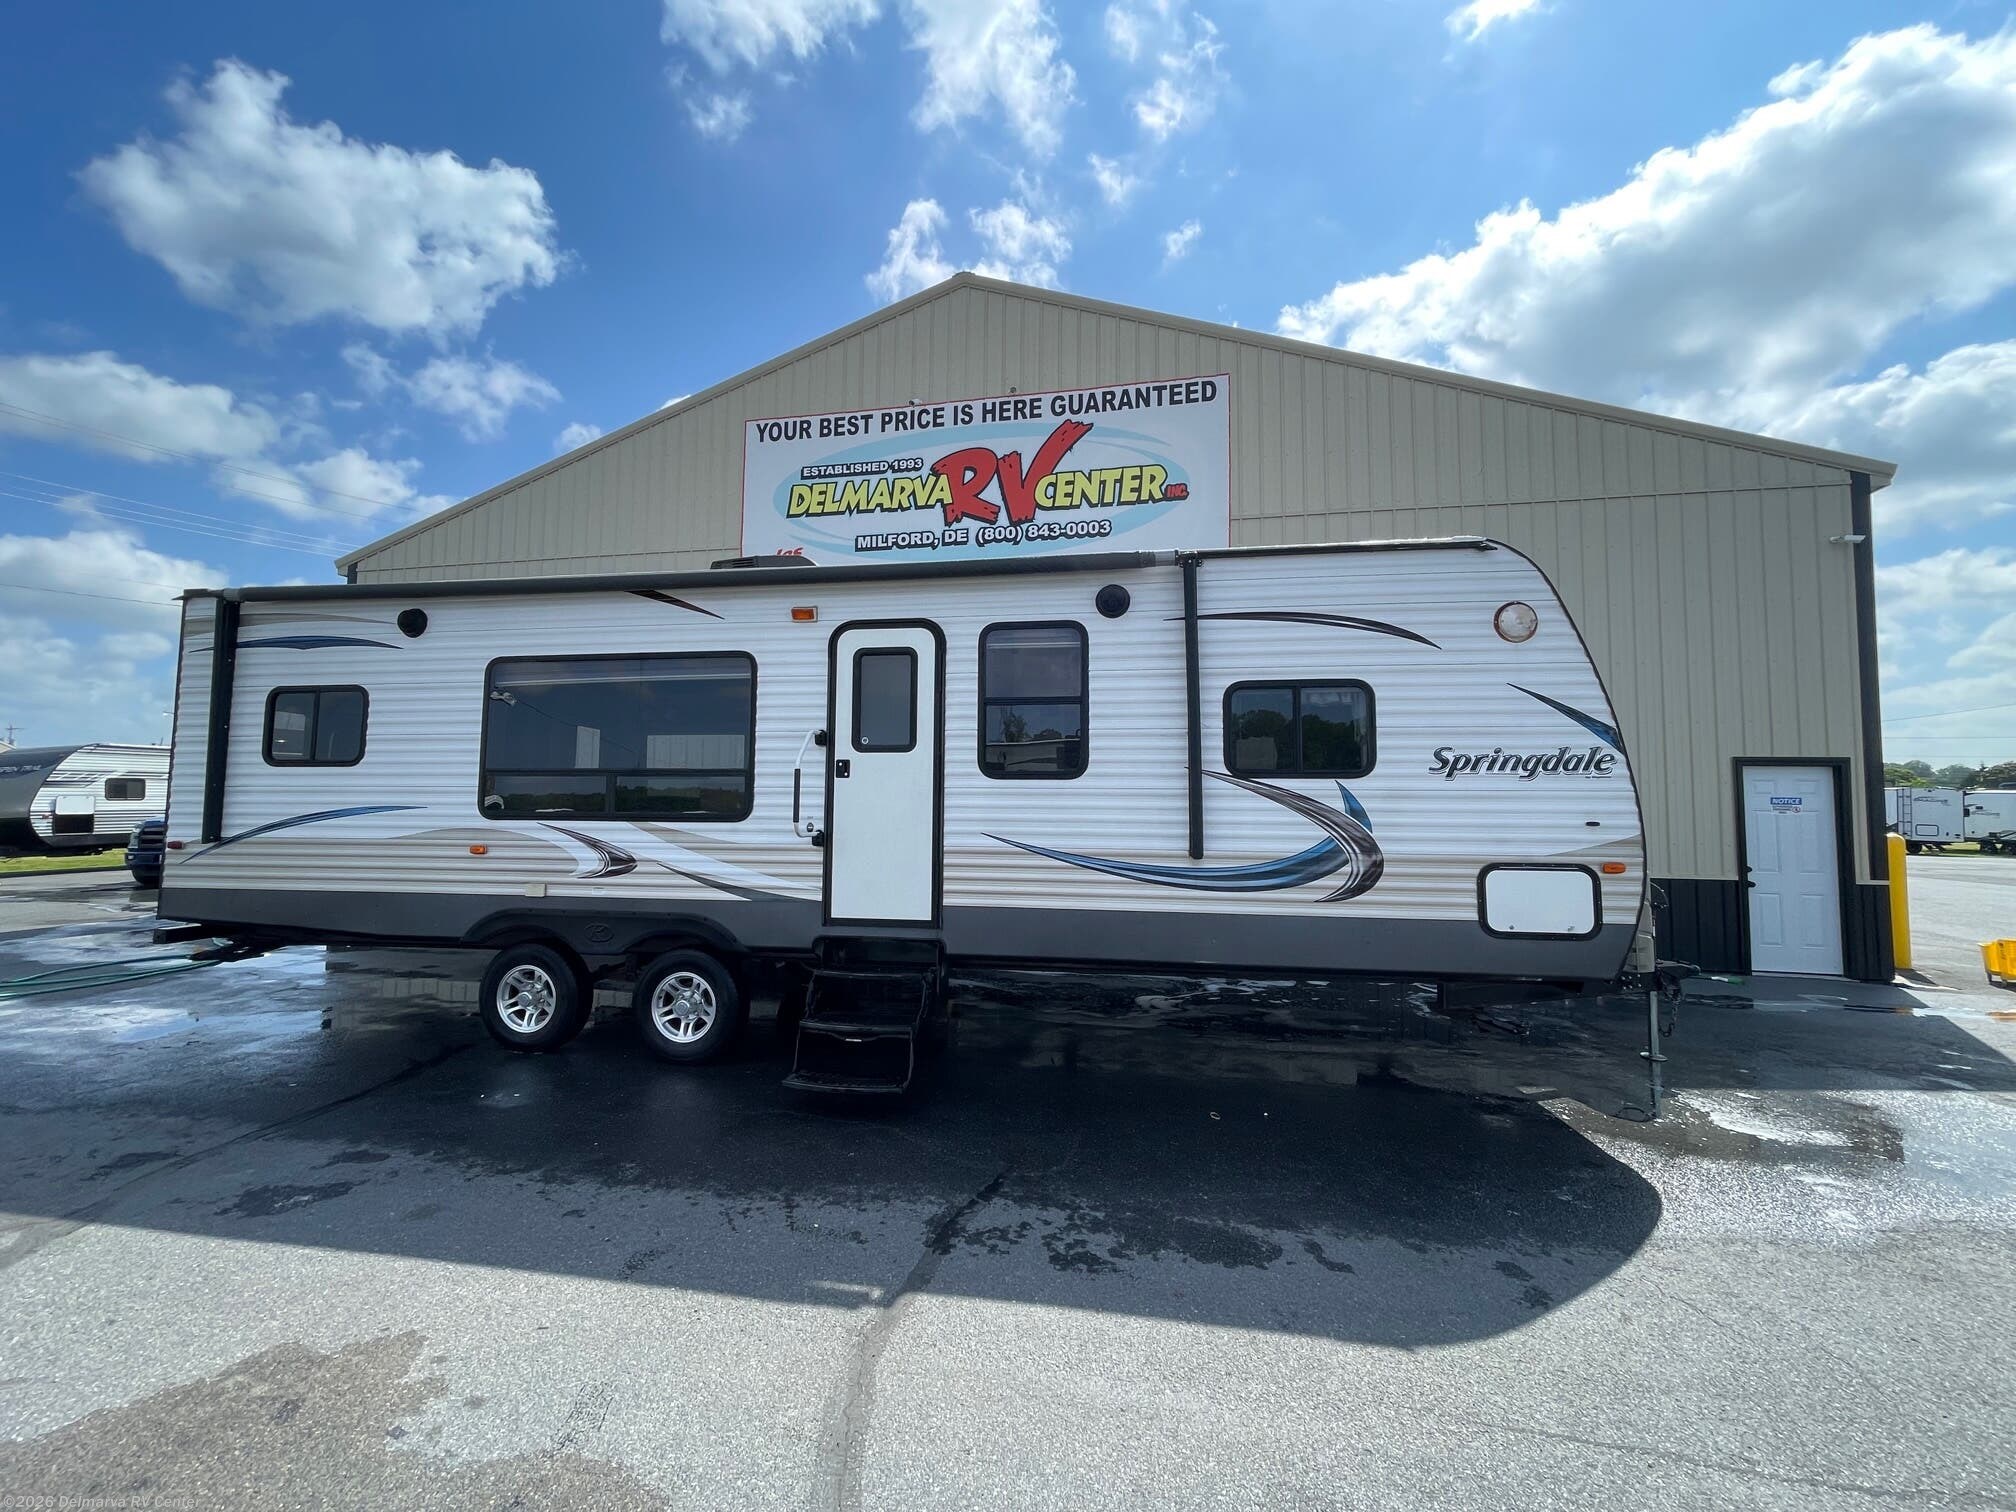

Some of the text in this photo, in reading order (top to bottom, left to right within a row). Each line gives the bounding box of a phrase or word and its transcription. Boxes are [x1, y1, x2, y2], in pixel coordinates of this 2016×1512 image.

[756, 380, 1217, 443] YOUR BEST PRICE IS HERE GUARANTEED
[787, 418, 1189, 528] DELMARVA RV CENTER INC.
[802, 458, 923, 478] ESTABLISHED 1993
[856, 521, 1111, 550] MILFORD, DE (800) 843-0003
[1428, 746, 1617, 781] Springdale
